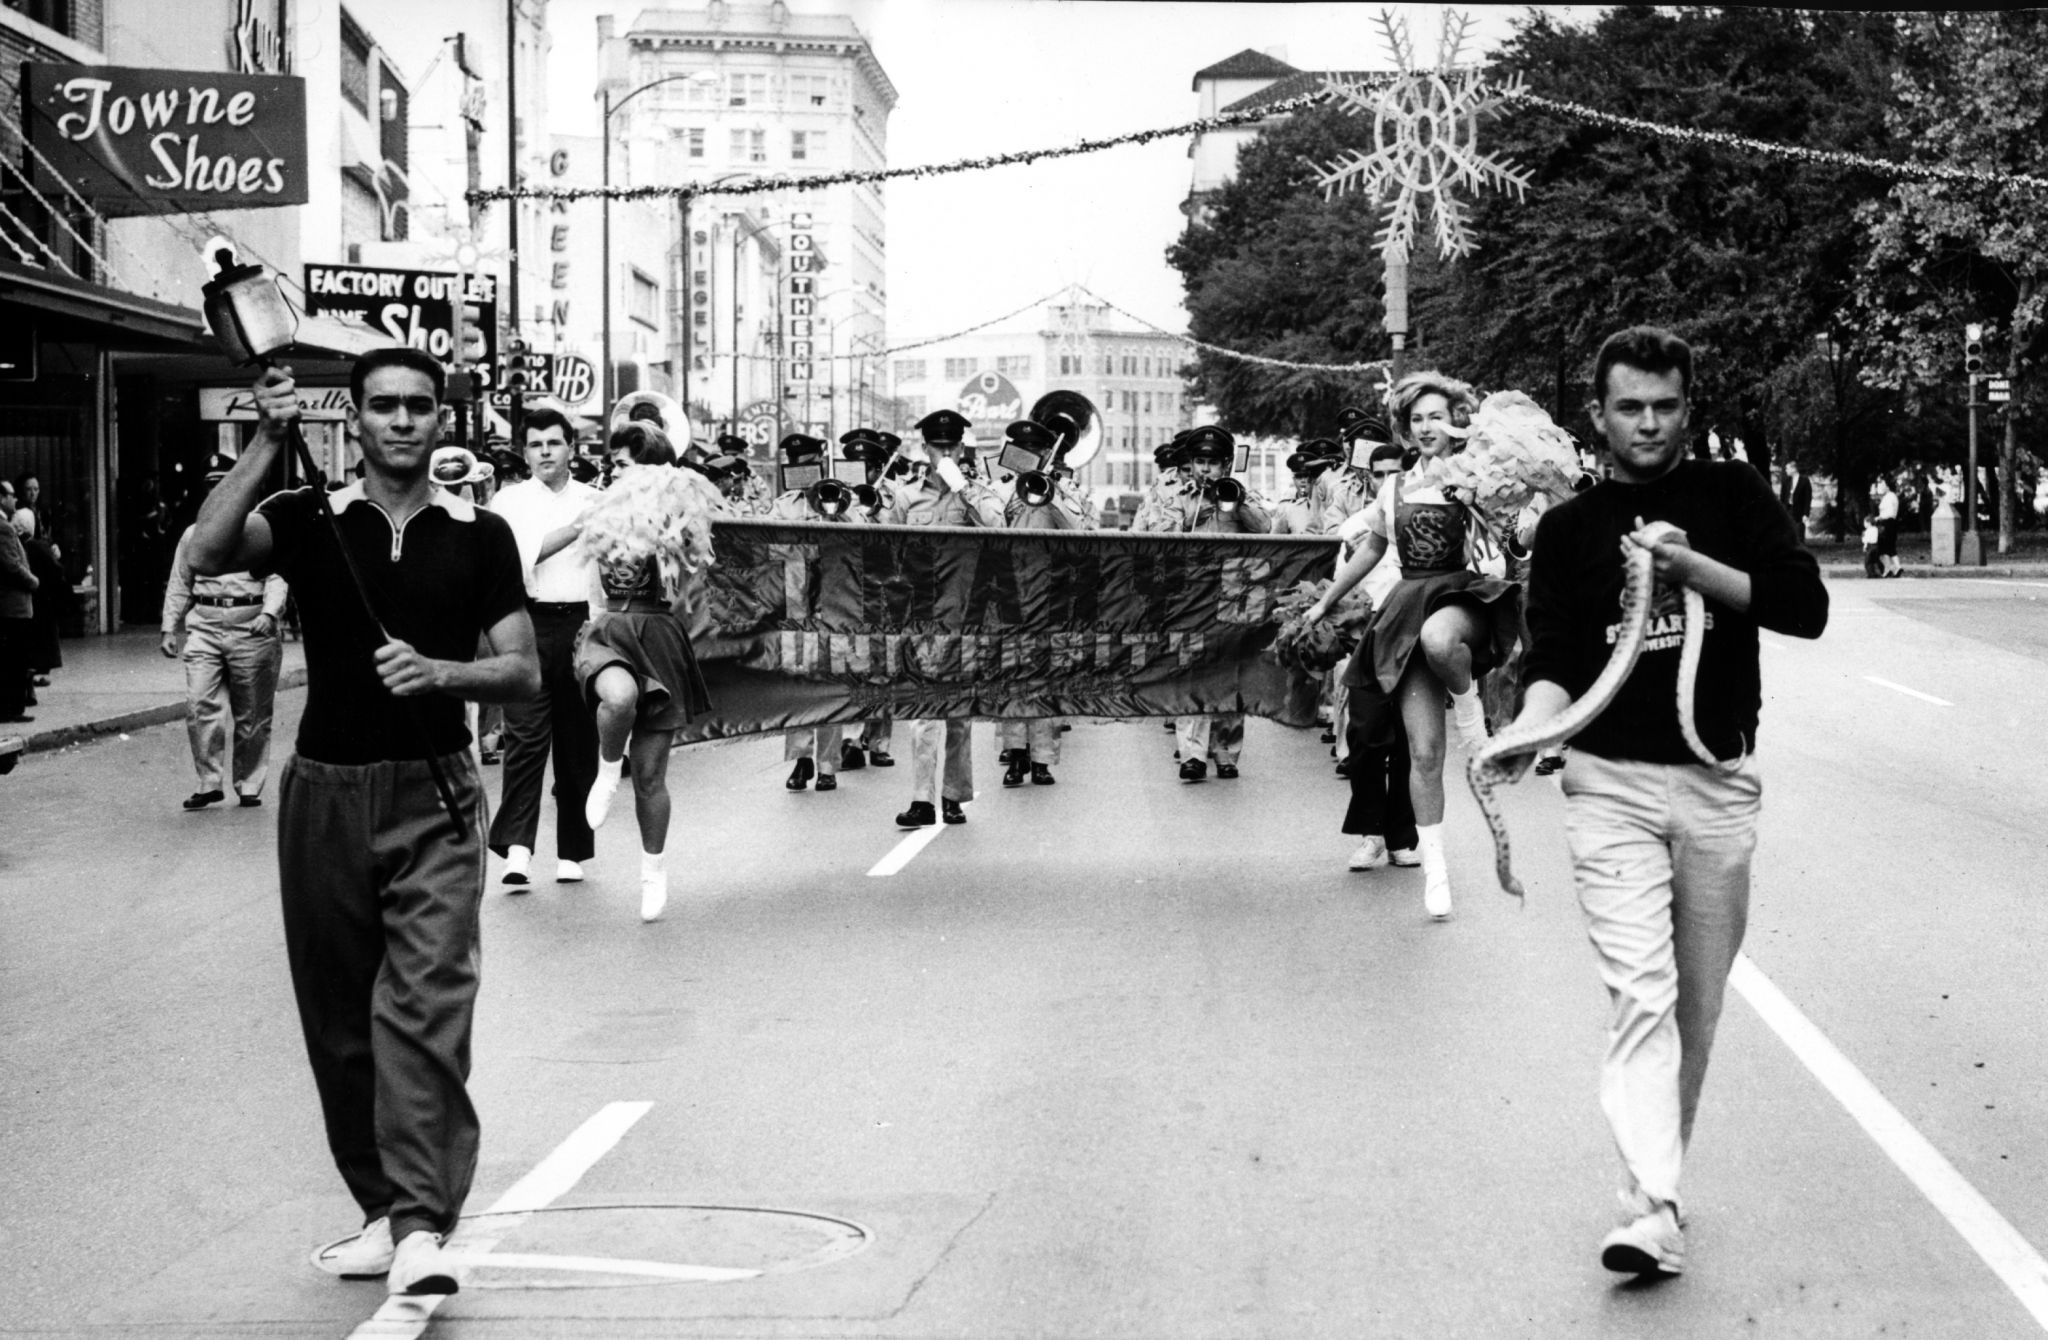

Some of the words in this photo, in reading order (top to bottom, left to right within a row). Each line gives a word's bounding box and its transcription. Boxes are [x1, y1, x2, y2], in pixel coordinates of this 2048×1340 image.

[57, 77, 255, 141] Towne
[145, 132, 285, 193] Shoes
[310, 269, 405, 297] FACTORY
[792, 213, 812, 379] OUTHERN
[781, 629, 1205, 677] UNIVERSITY
